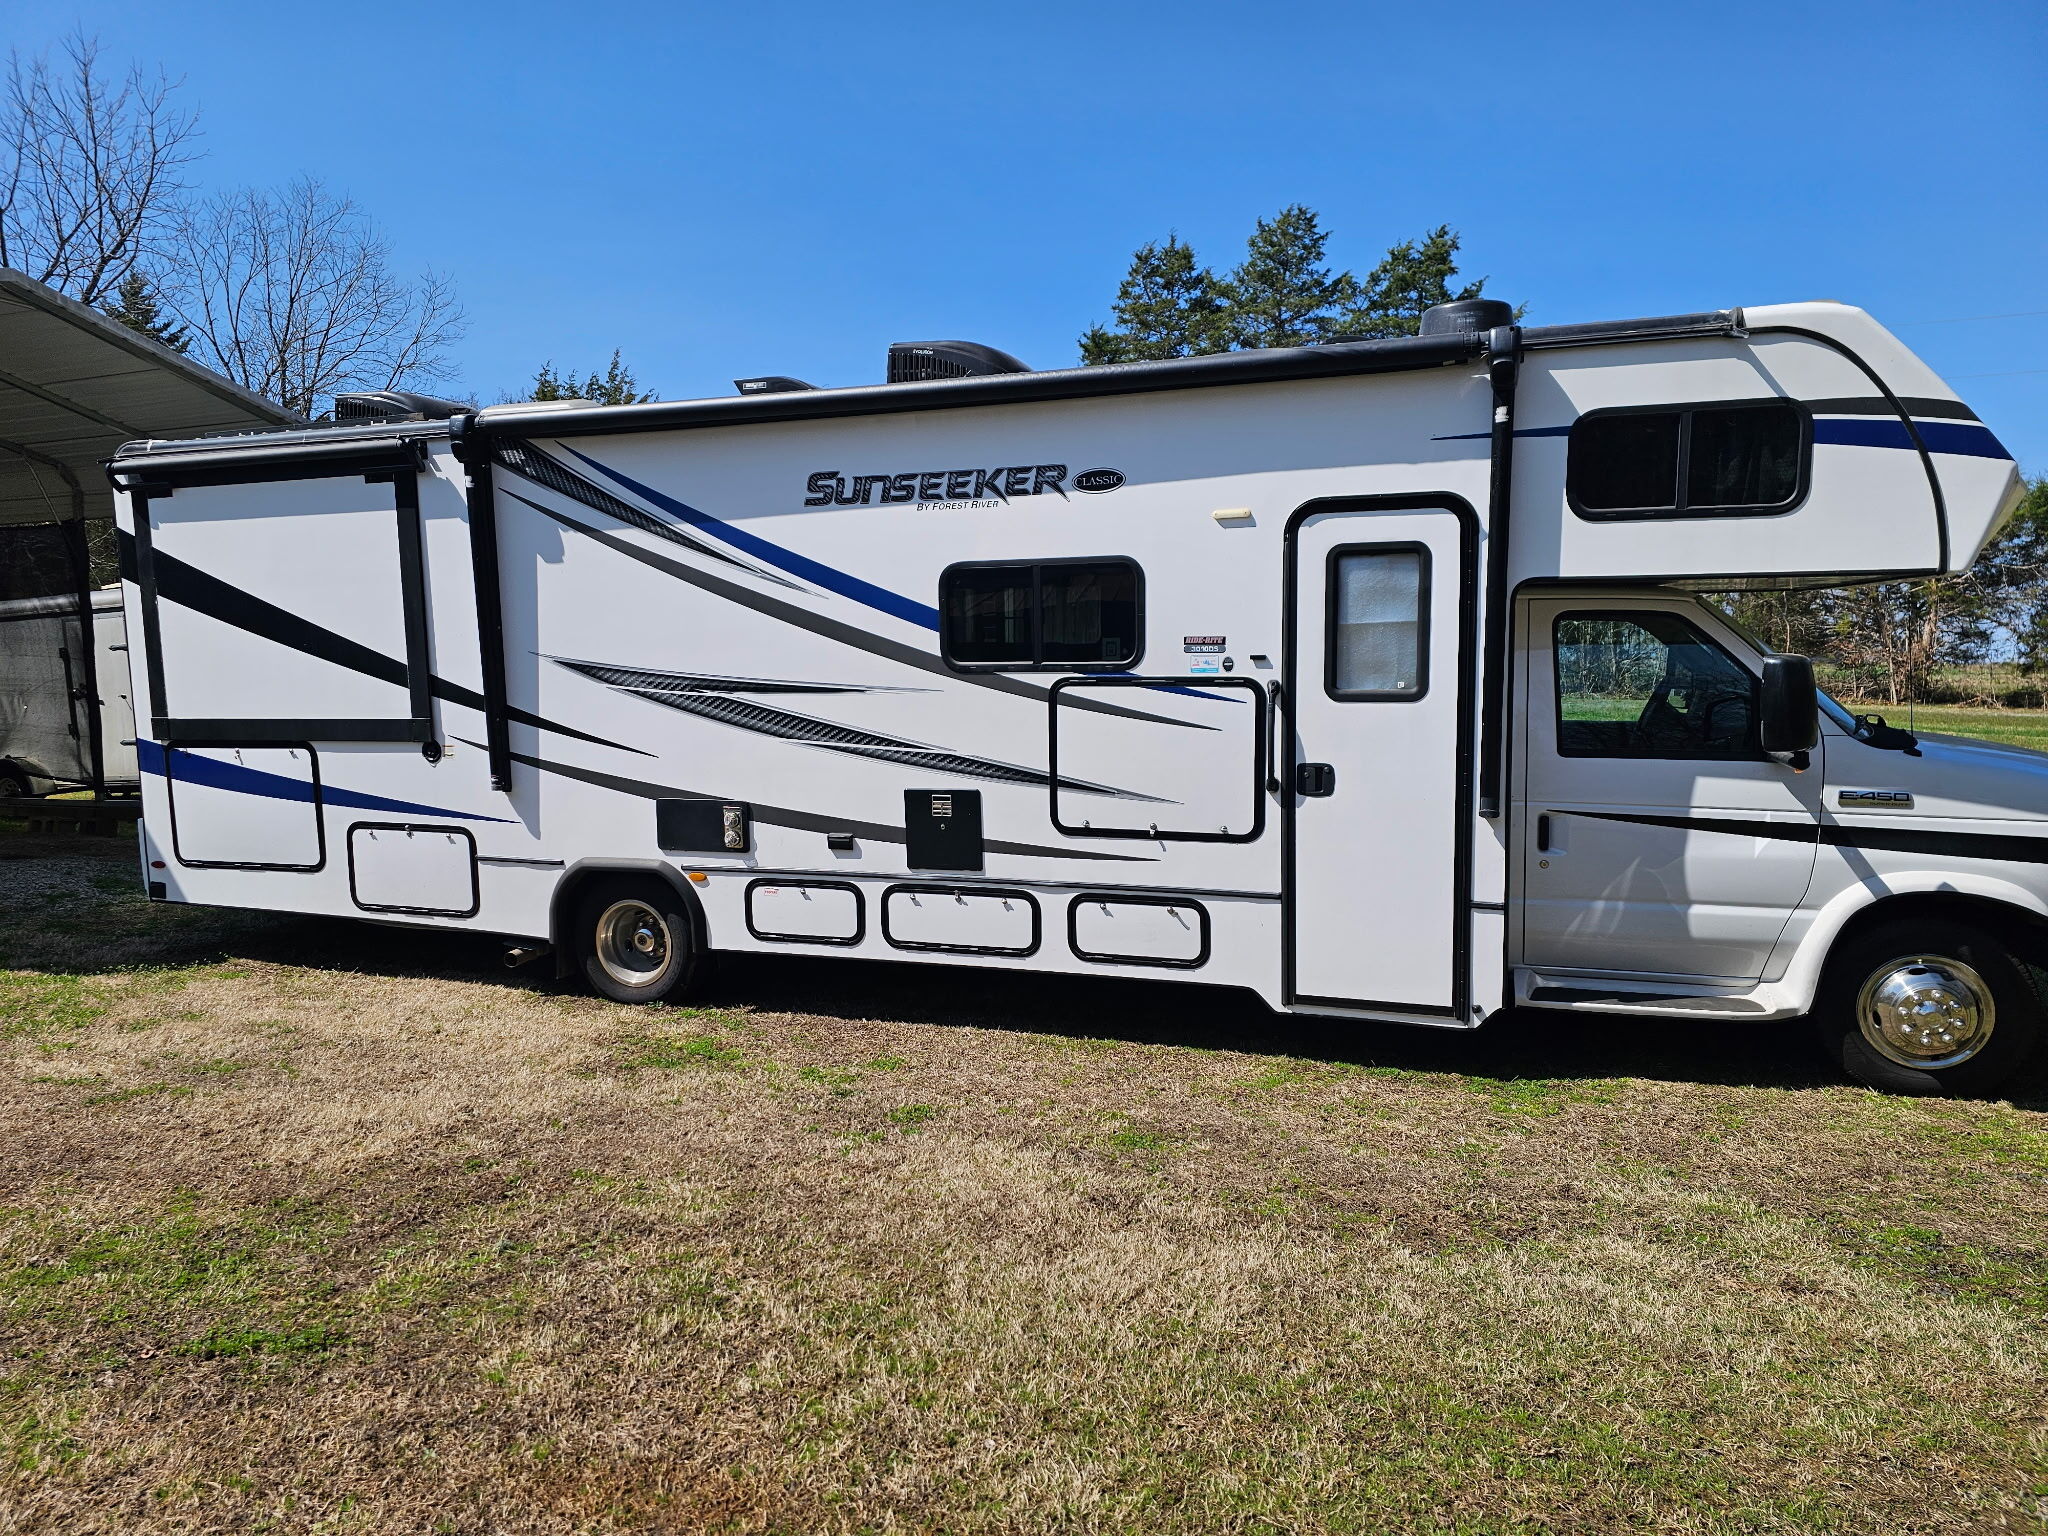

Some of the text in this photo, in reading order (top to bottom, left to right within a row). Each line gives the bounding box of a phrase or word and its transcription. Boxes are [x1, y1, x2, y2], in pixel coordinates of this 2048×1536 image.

[1074, 474, 1122, 487] CLASSIC
[916, 500, 999, 512] BY FOREST RIVER
[1184, 635, 1224, 645] RIDE-RITE
[1839, 790, 1910, 802] E-450
